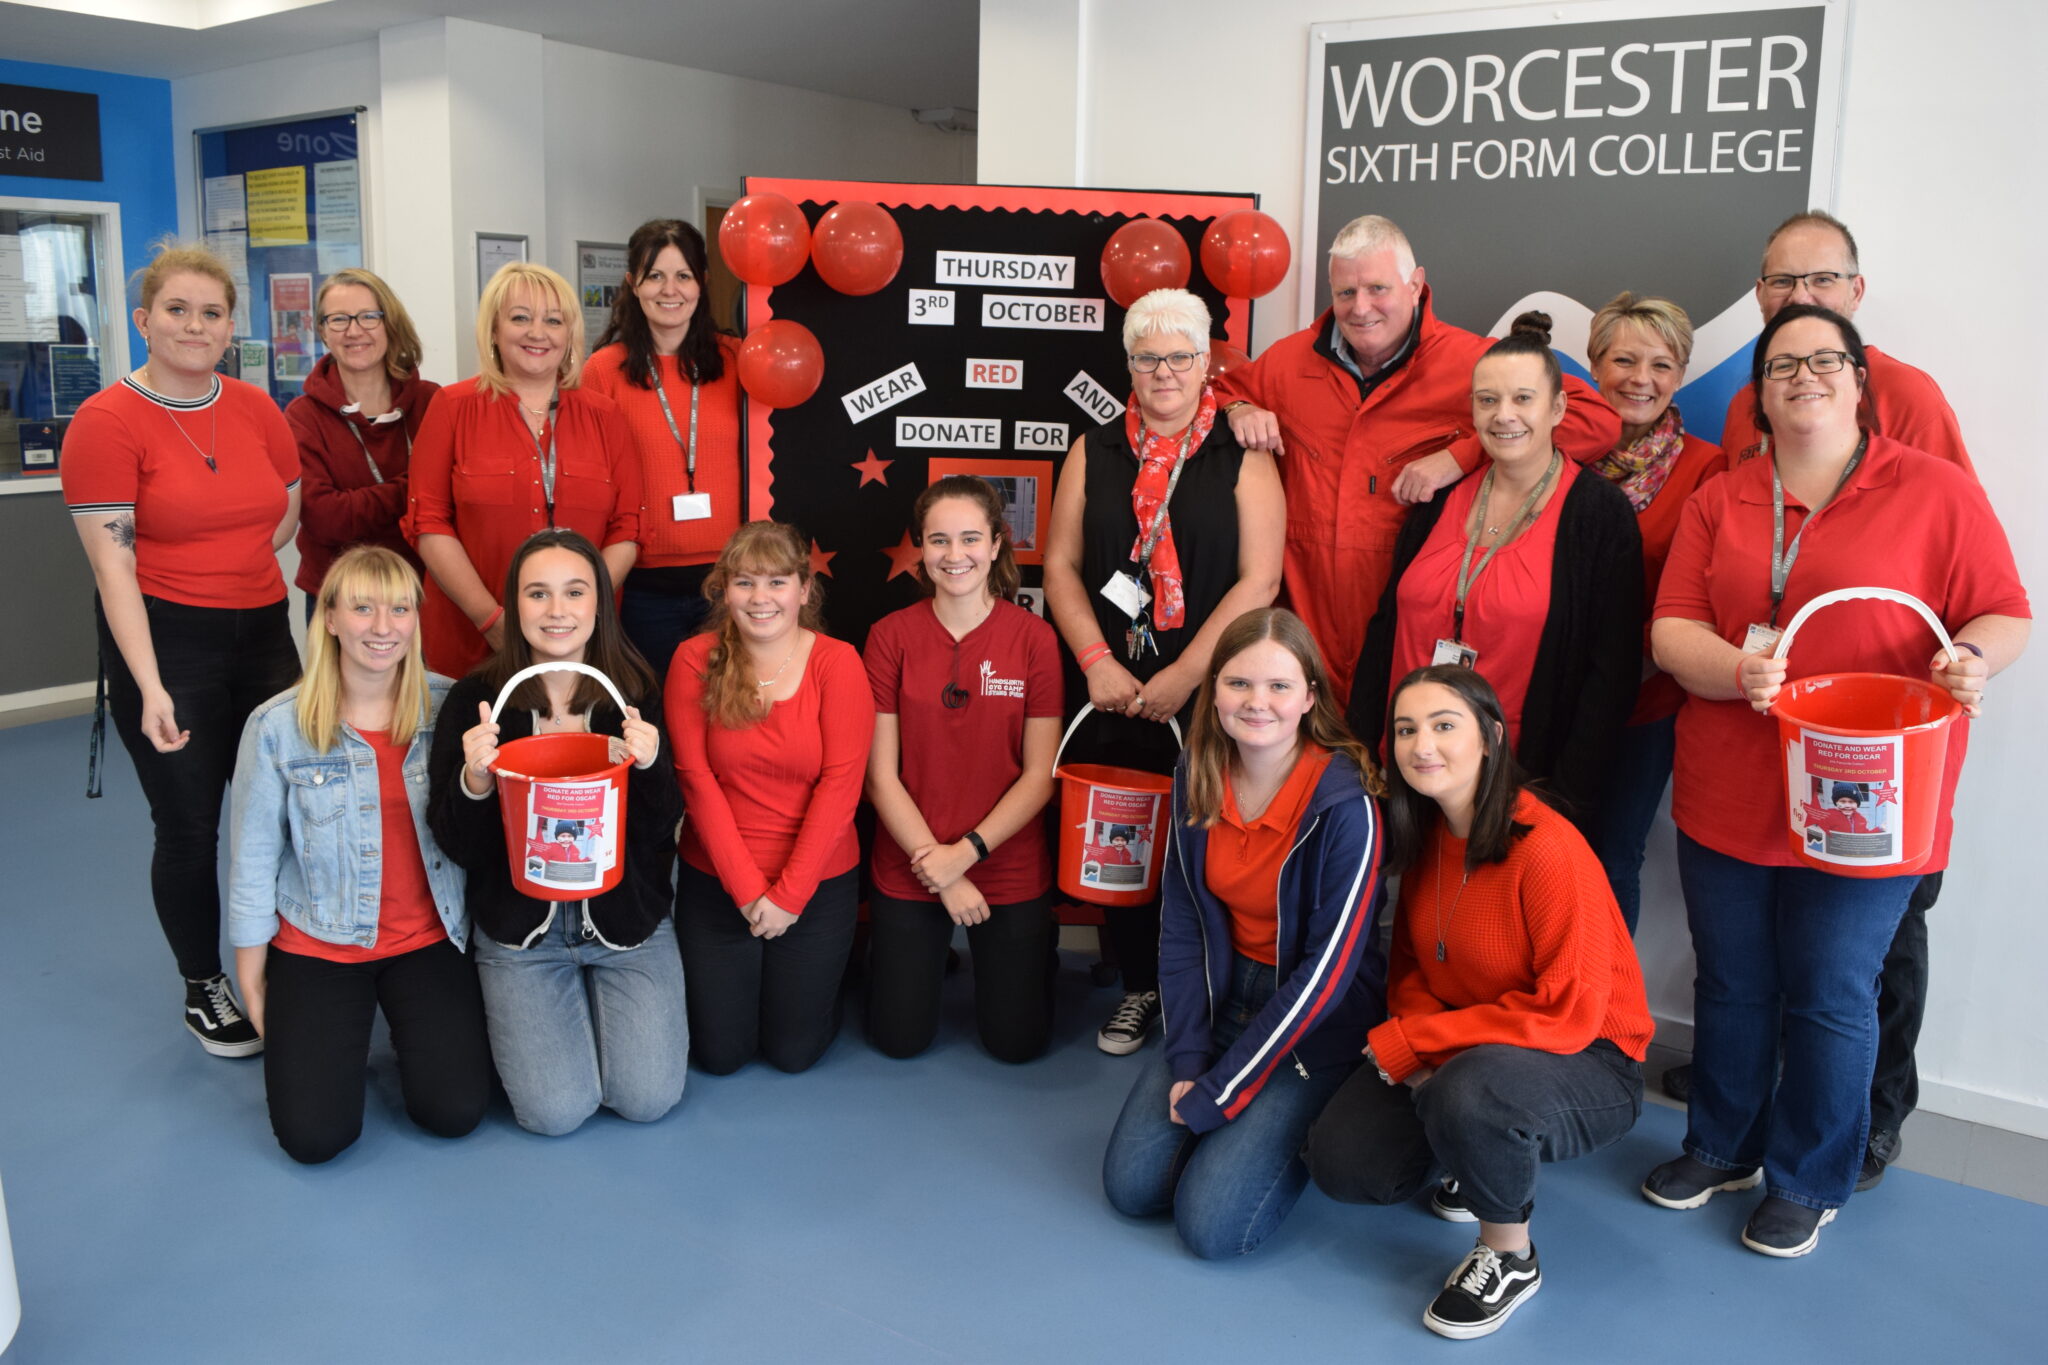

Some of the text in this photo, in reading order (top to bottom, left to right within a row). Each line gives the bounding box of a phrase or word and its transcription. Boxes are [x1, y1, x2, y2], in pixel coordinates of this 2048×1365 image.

[1330, 34, 1808, 130] WORCESTER
[16, 146, 45, 162] Aid
[1326, 128, 1804, 185] SIXTH FORM COLLEGE
[942, 258, 1068, 282] THURSDAY
[915, 295, 1097, 324] 3RD OCTOBER
[973, 363, 1018, 384] RED
[849, 371, 918, 414] WEAR
[1070, 380, 1117, 420] AND
[902, 422, 1064, 447] DONATE FOR
[1812, 740, 1843, 751] DONATE
[1862, 745, 1888, 753] WEAR
[1817, 749, 1833, 758] RED
[1852, 753, 1881, 761] OSCAR
[1813, 762, 1843, 774] THURSDAY
[543, 787, 569, 795] DONATE
[584, 787, 601, 795] WEAR
[1100, 792, 1123, 800] DONATE
[1103, 798, 1116, 806] RED
